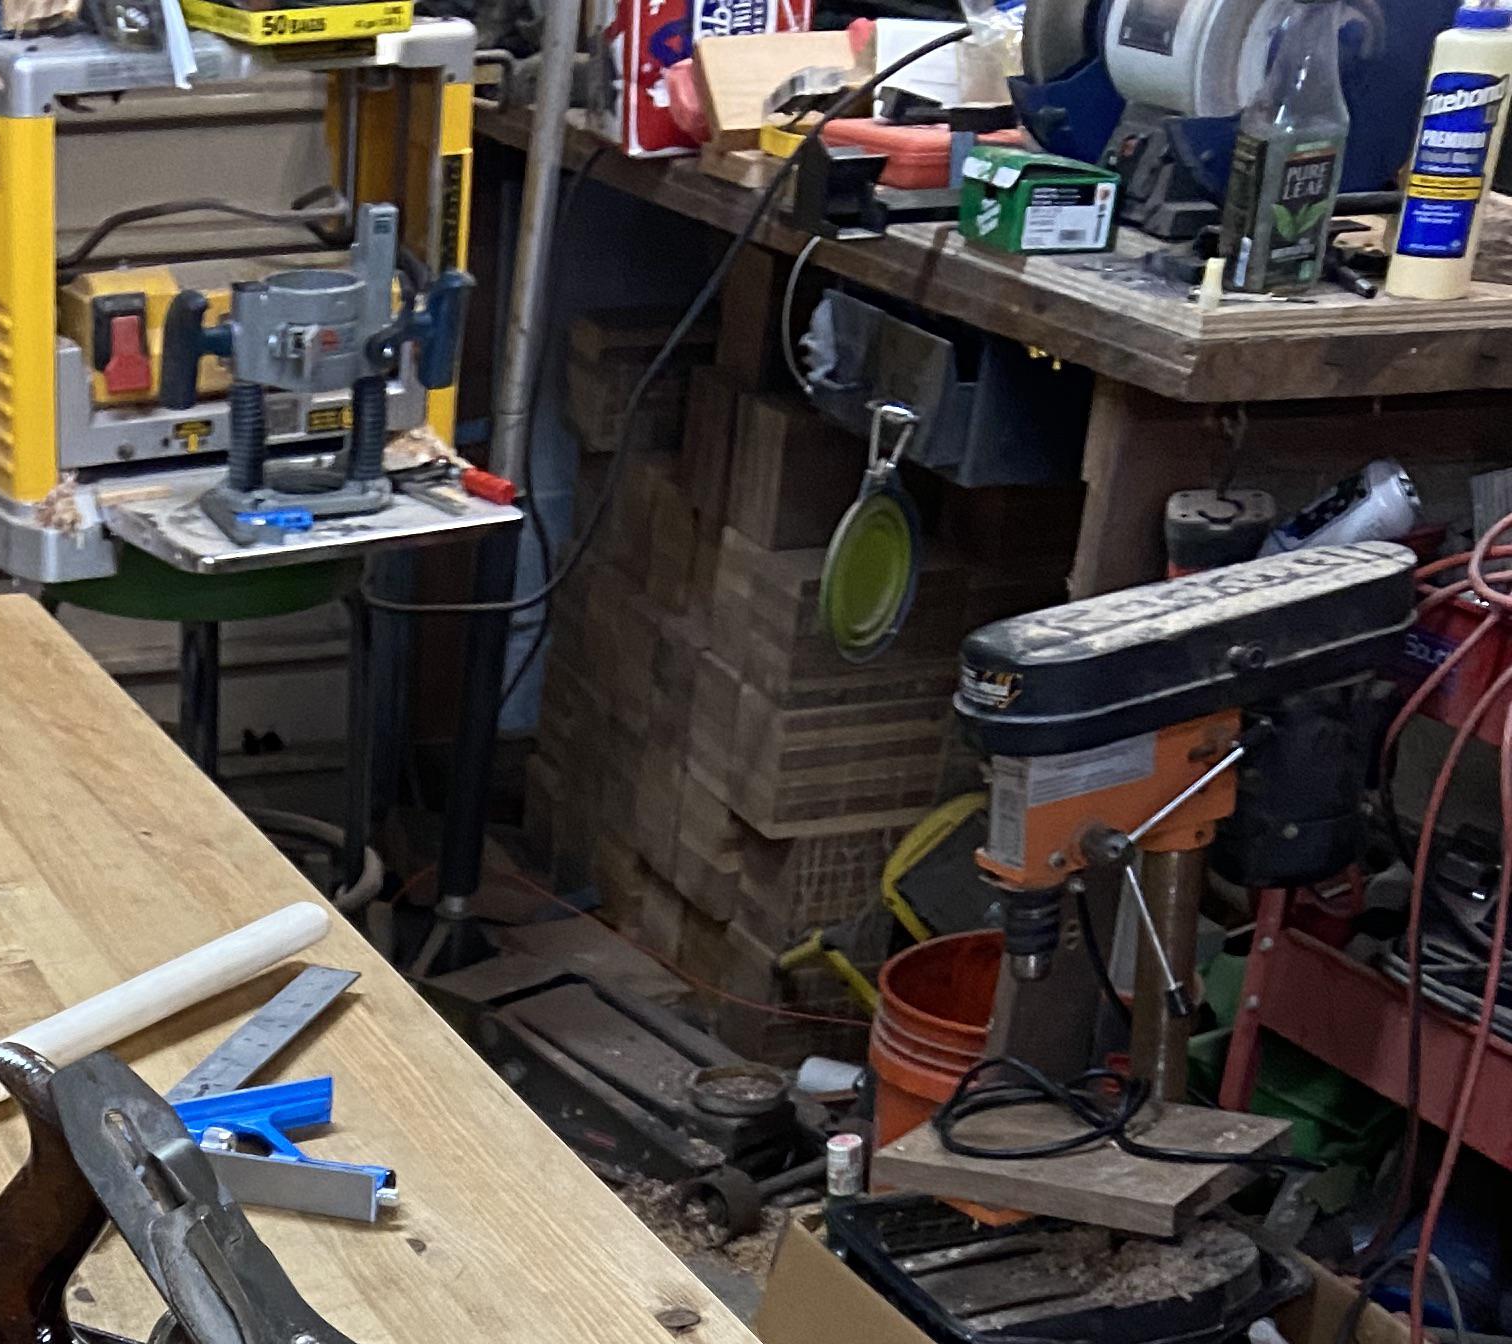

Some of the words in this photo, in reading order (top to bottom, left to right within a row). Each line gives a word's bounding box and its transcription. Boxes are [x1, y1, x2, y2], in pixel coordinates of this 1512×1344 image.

[262, 15, 287, 36] 50
[1286, 160, 1329, 182] PURE
[1281, 178, 1323, 201] LEAF
